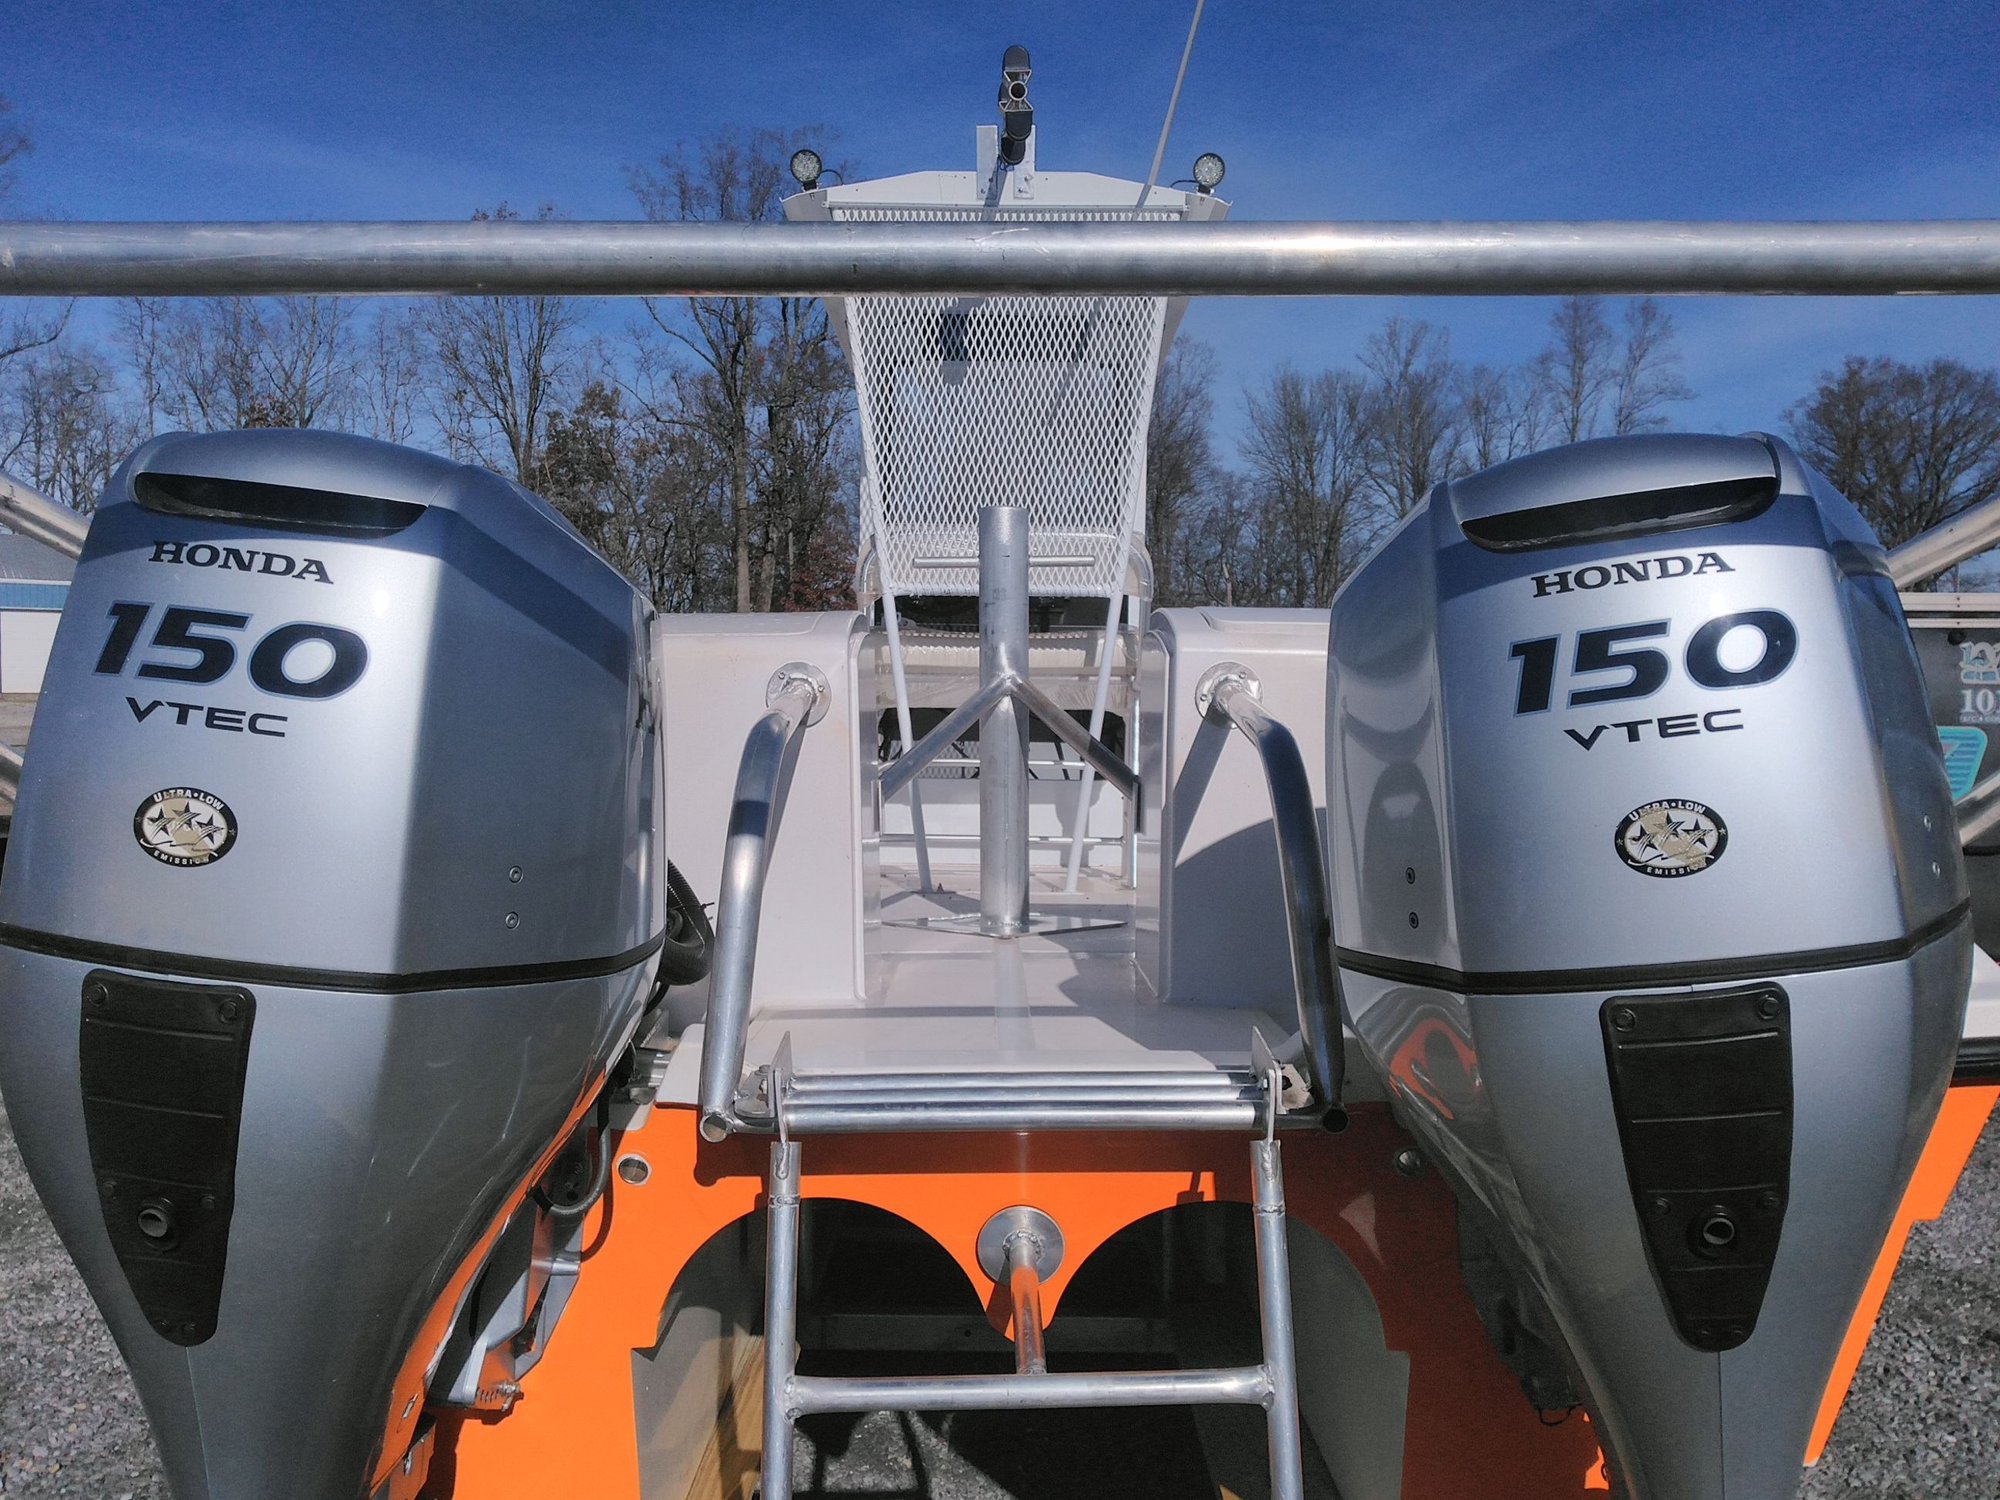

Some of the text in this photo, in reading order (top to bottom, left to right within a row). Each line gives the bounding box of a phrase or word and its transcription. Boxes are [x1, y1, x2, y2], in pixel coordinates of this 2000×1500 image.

[148, 540, 334, 585] HONDA
[1531, 552, 1736, 598] HONDA
[92, 600, 371, 702] 150
[1507, 607, 1800, 718] 150
[126, 696, 288, 738] VTEC
[1960, 688, 2000, 714] 10
[1563, 708, 1744, 751] VTEC
[199, 793, 224, 811] LOW
[1678, 801, 1706, 815] LOW
